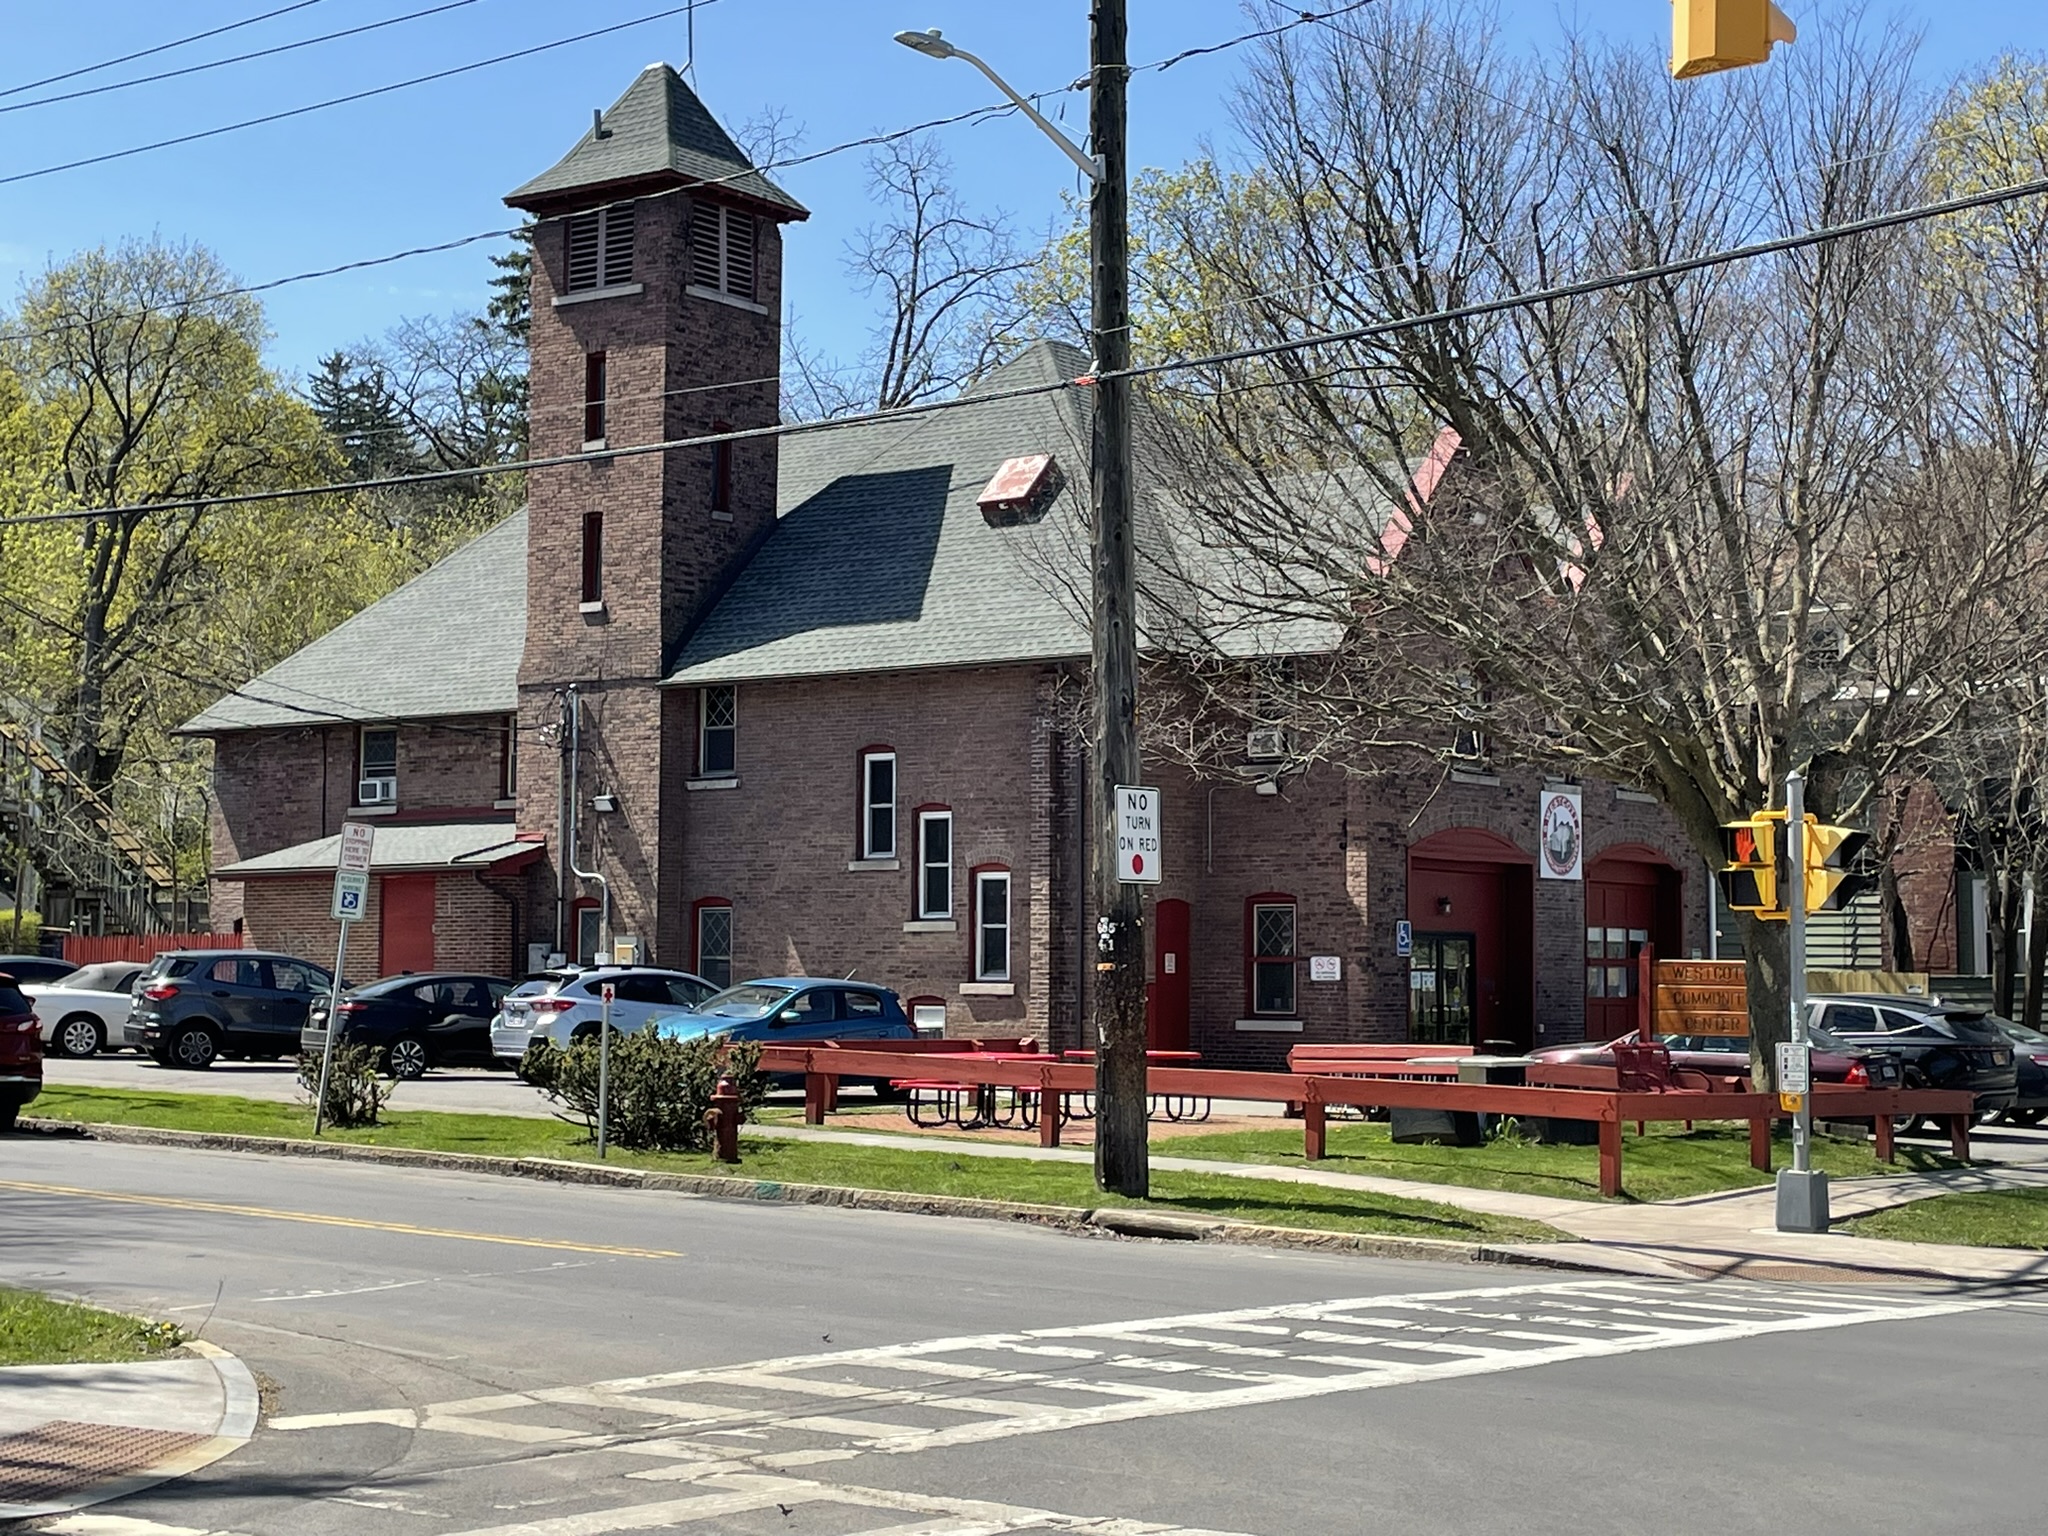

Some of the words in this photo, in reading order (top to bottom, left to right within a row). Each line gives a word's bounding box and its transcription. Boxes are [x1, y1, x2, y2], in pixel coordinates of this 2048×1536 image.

[1127, 793, 1148, 811] NO
[1125, 815, 1151, 830] TURN
[352, 827, 366, 838] NO
[1119, 836, 1134, 850] ON
[1139, 837, 1158, 852] RED
[1672, 965, 1745, 981] WESTCOT
[1673, 991, 1744, 1006] COMMUNIT
[1684, 1016, 1741, 1031] CENTER
